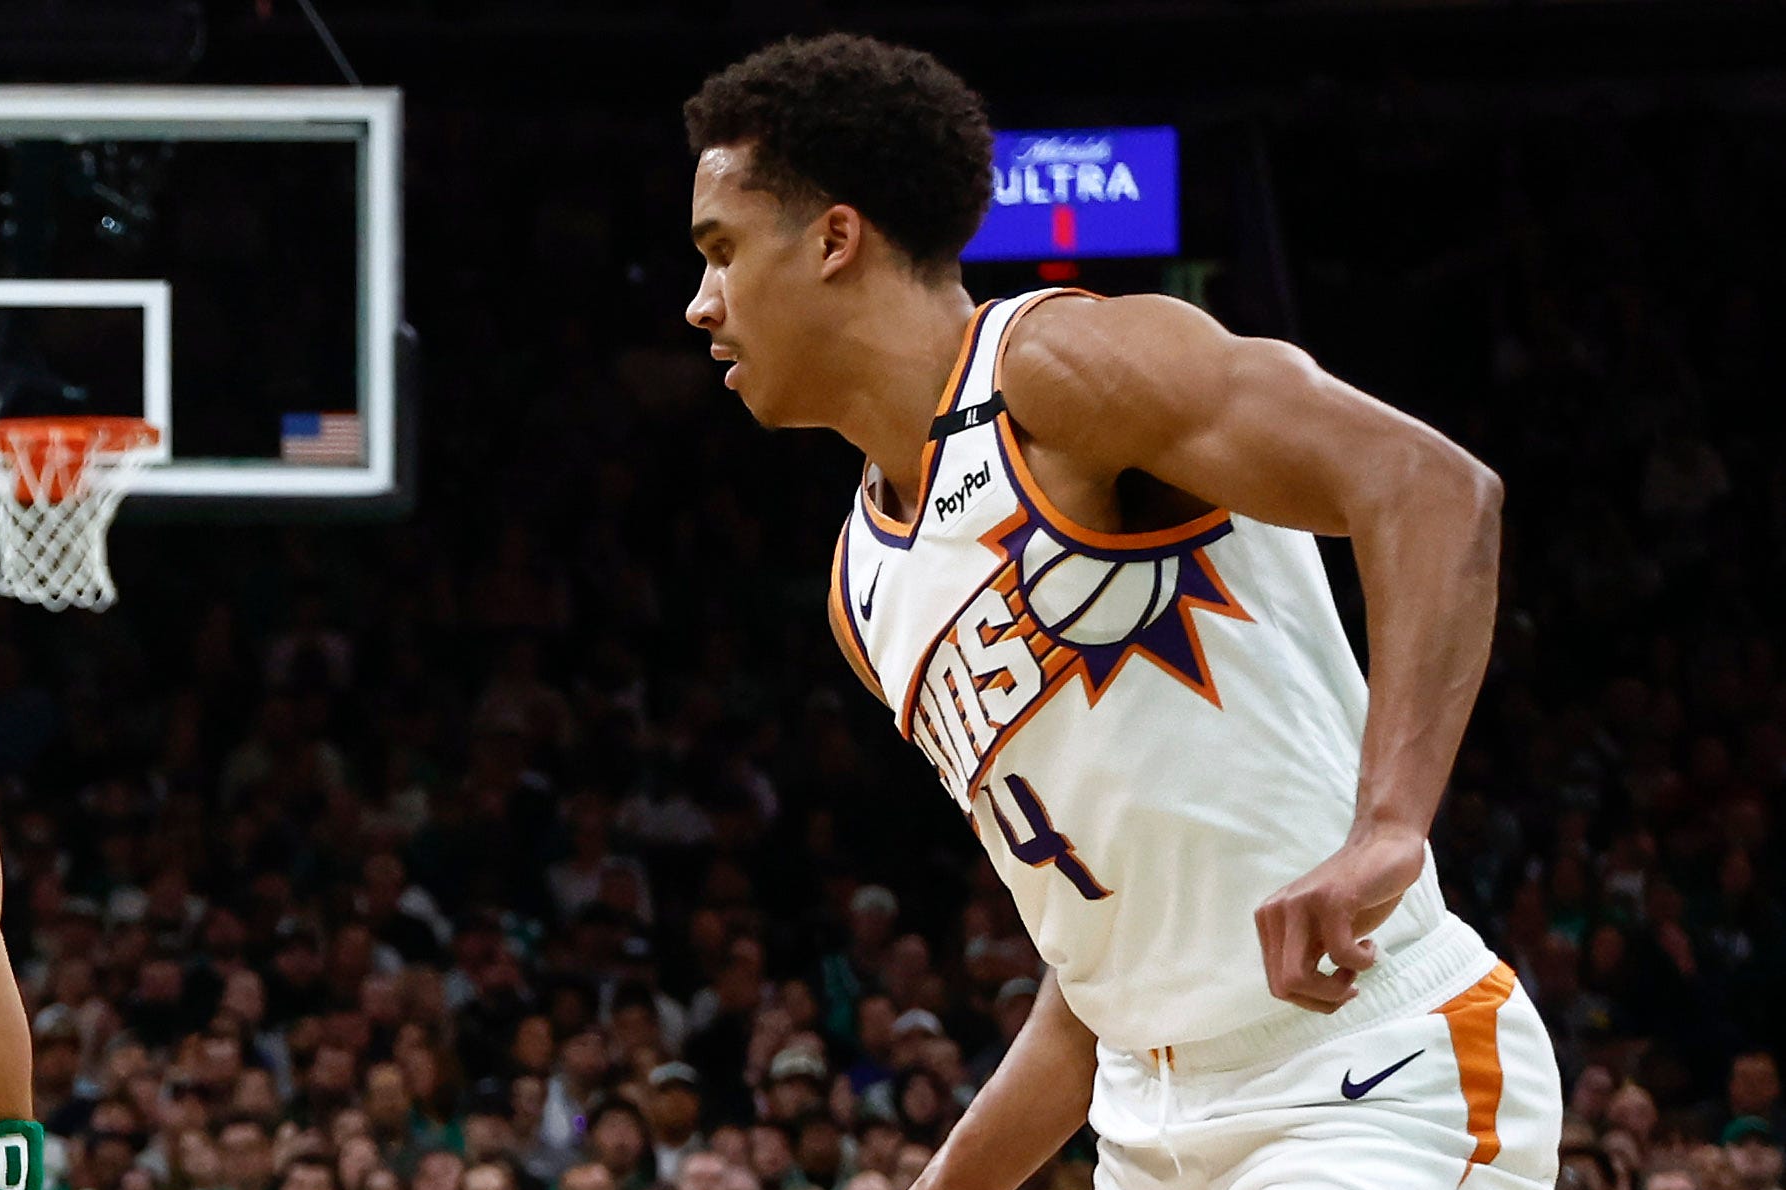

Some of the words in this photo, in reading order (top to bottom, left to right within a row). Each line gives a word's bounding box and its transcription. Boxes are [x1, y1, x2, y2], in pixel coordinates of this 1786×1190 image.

[992, 162, 1141, 205] ULTRA
[934, 460, 991, 522] PayPal
[913, 588, 1042, 813] UNS
[978, 774, 1114, 900] 4
